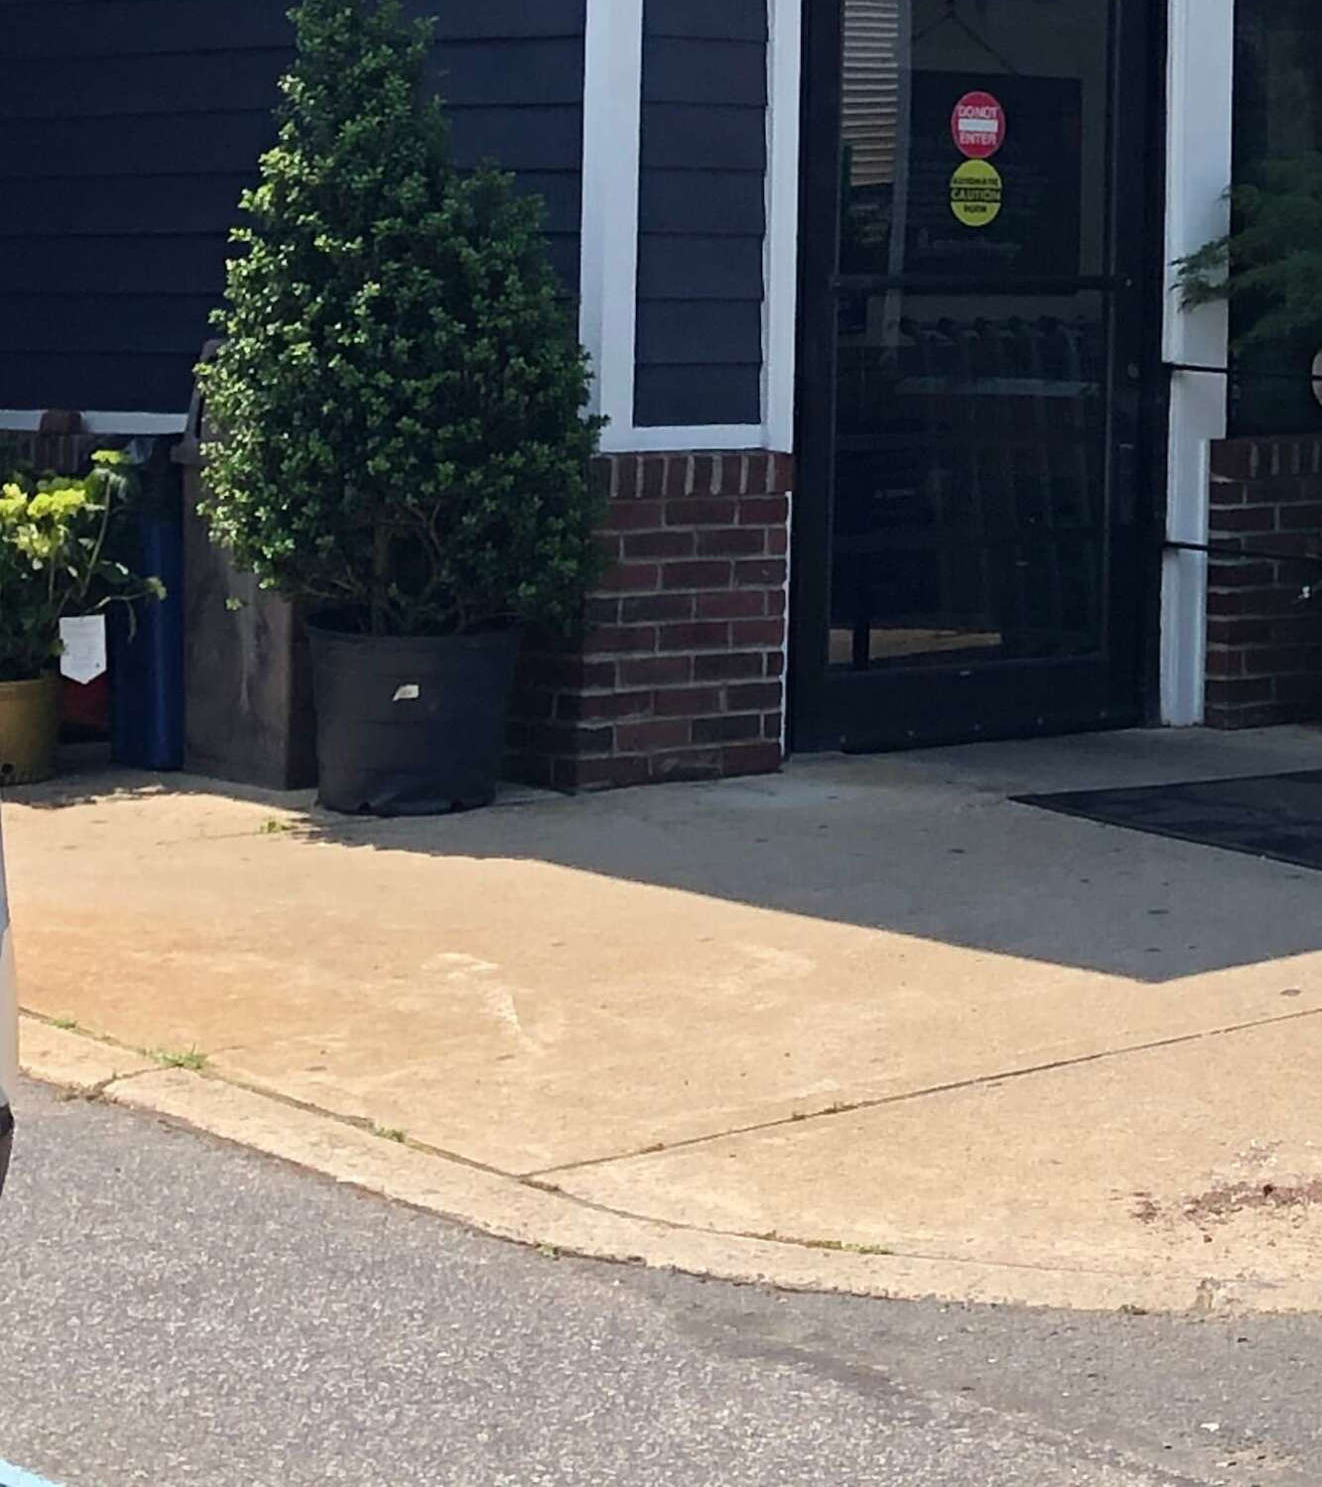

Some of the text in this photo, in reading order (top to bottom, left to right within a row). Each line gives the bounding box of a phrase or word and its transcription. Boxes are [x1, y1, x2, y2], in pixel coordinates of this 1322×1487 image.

[958, 105, 998, 119] DO NOT
[959, 132, 997, 145] ENTER
[951, 188, 1001, 201] CAUTION
